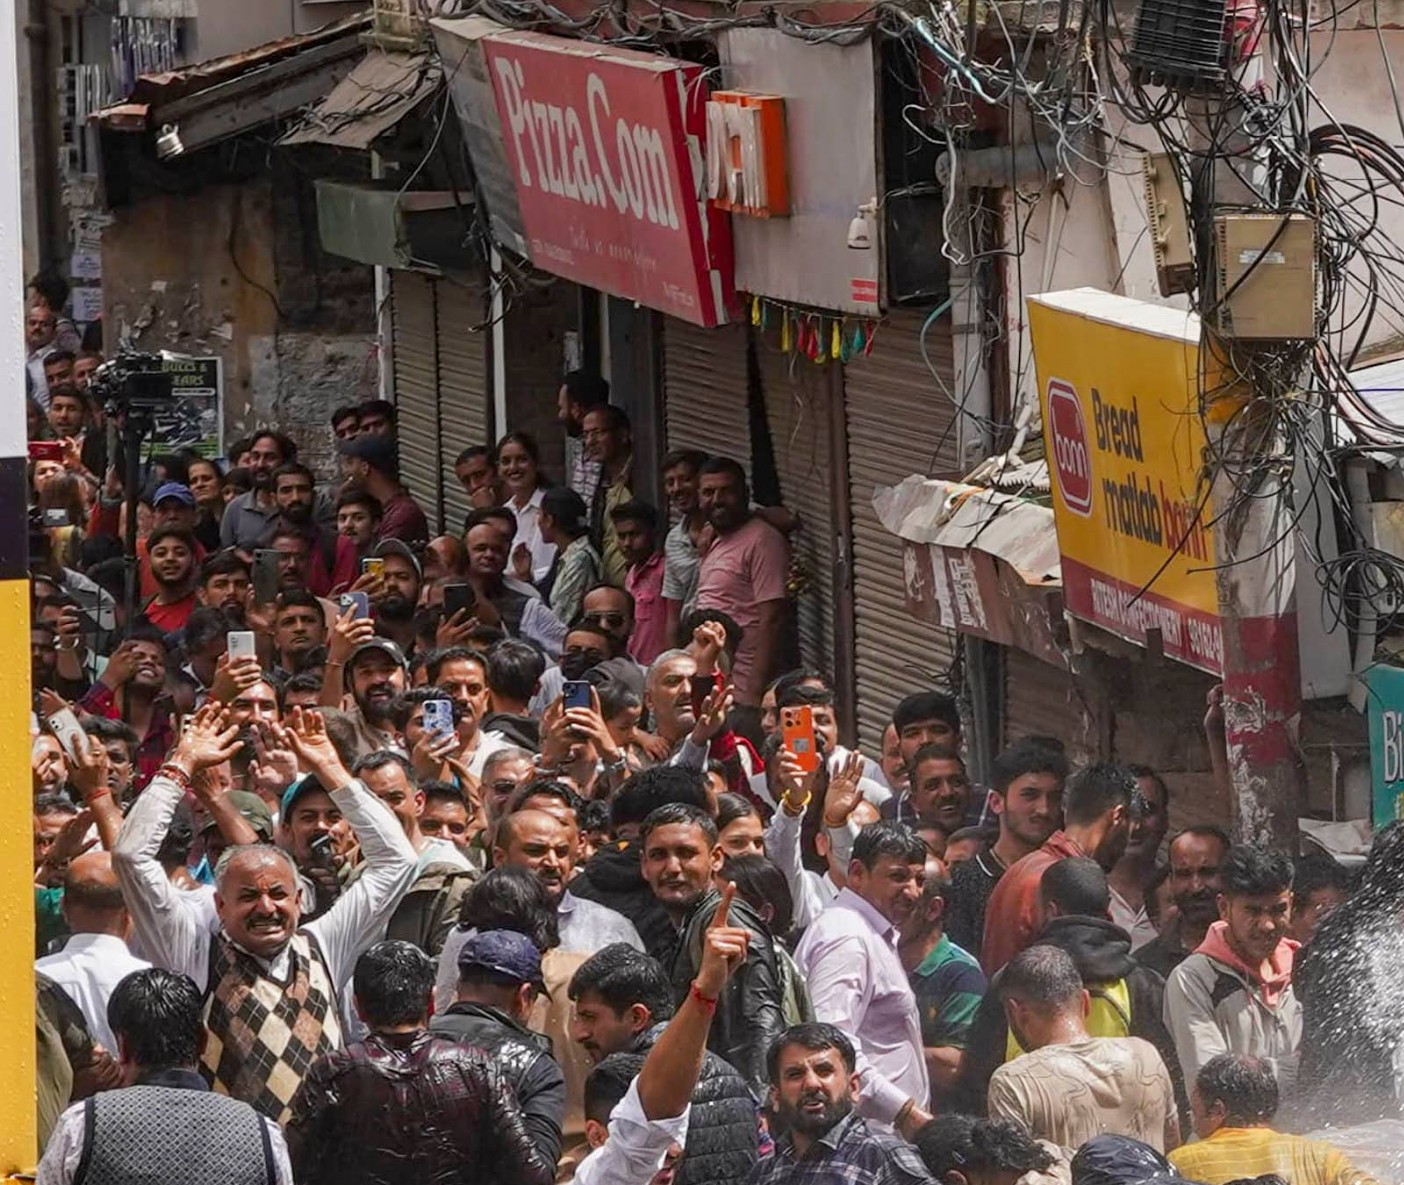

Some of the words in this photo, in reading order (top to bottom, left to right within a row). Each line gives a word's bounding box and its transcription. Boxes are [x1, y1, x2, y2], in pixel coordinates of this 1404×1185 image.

[494, 56, 680, 231] Pizza.Com
[1091, 387, 1143, 463] Bread
[1102, 471, 1163, 548] matlab
